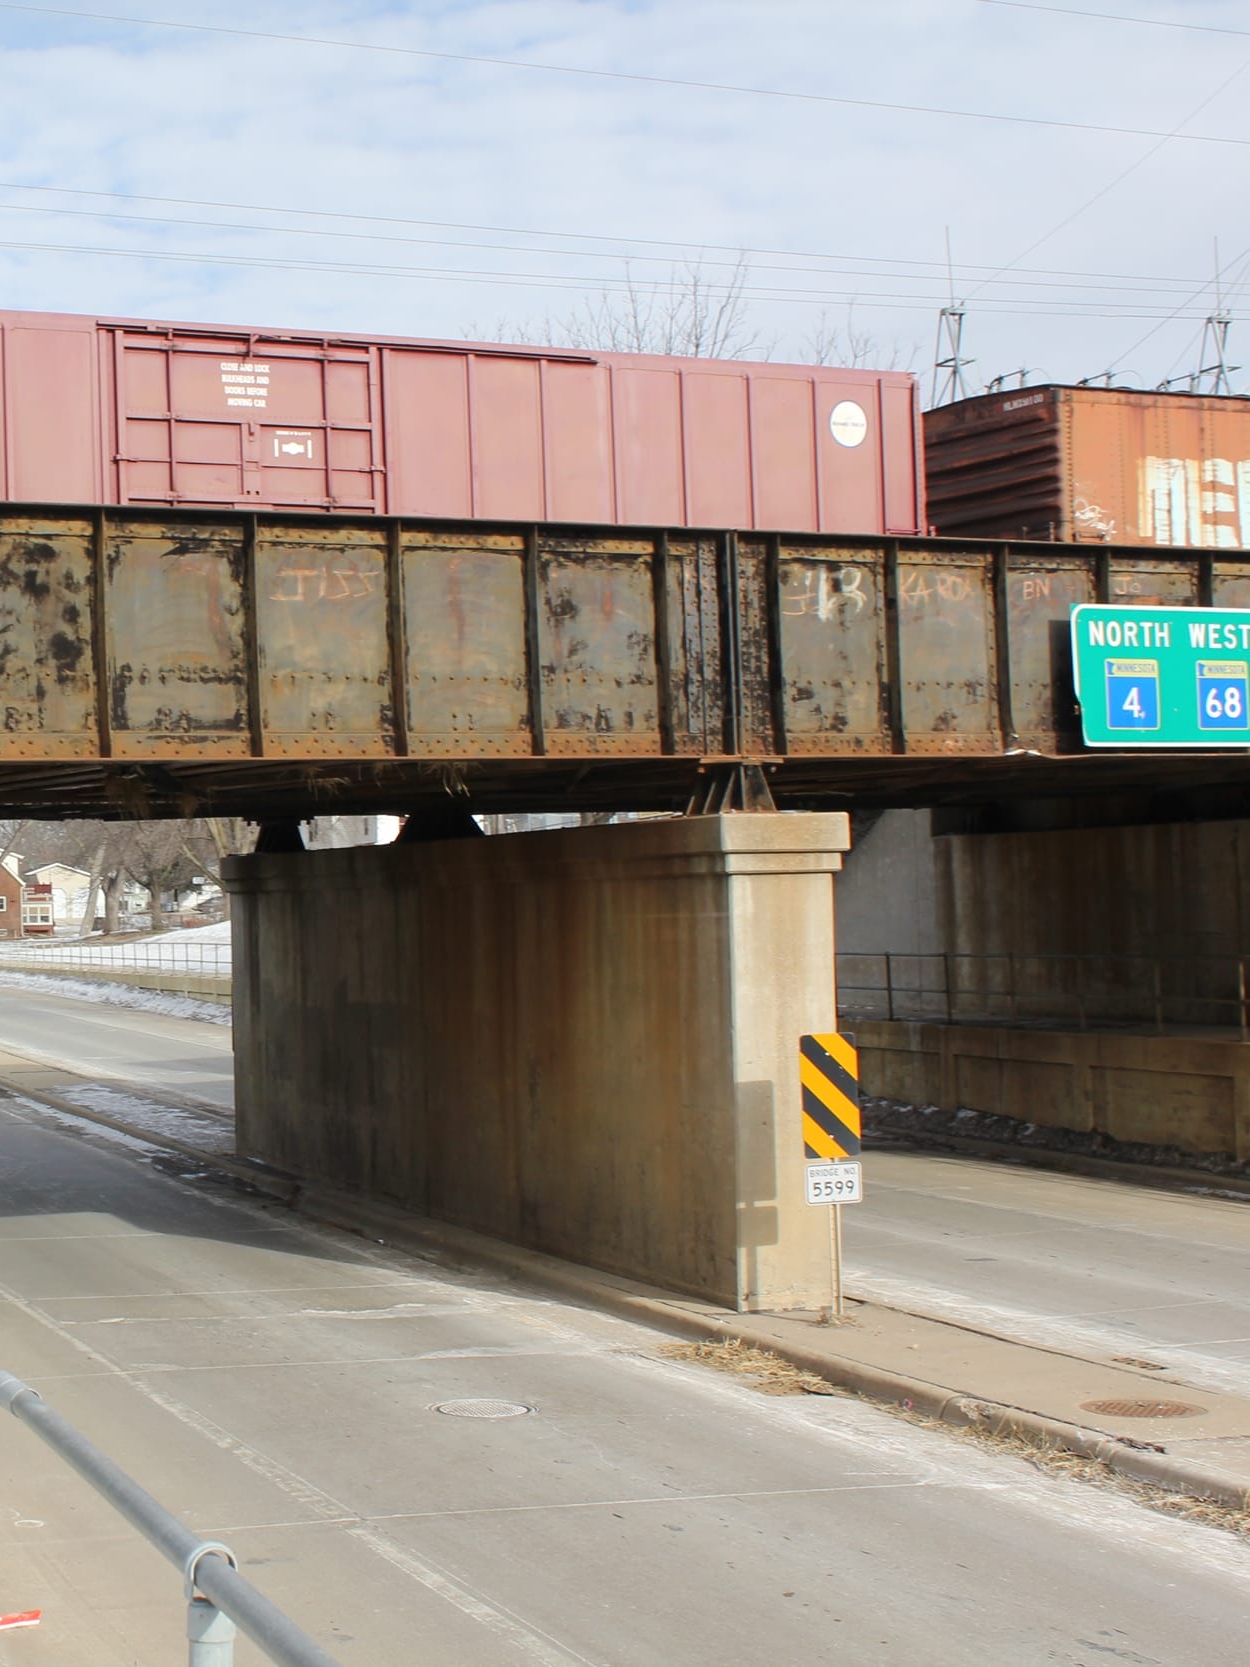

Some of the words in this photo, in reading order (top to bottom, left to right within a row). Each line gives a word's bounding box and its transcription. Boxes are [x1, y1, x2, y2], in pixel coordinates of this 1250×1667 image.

[1088, 620, 1171, 648] NORTH
[1188, 623, 1250, 650] WEST
[1116, 663, 1155, 673] MINNESOTA
[1206, 664, 1246, 674] MINNESOTA
[1122, 686, 1142, 718] 4
[1205, 686, 1242, 718] 68
[809, 1168, 839, 1178] BRIDGE
[813, 1180, 855, 1197] 5599
